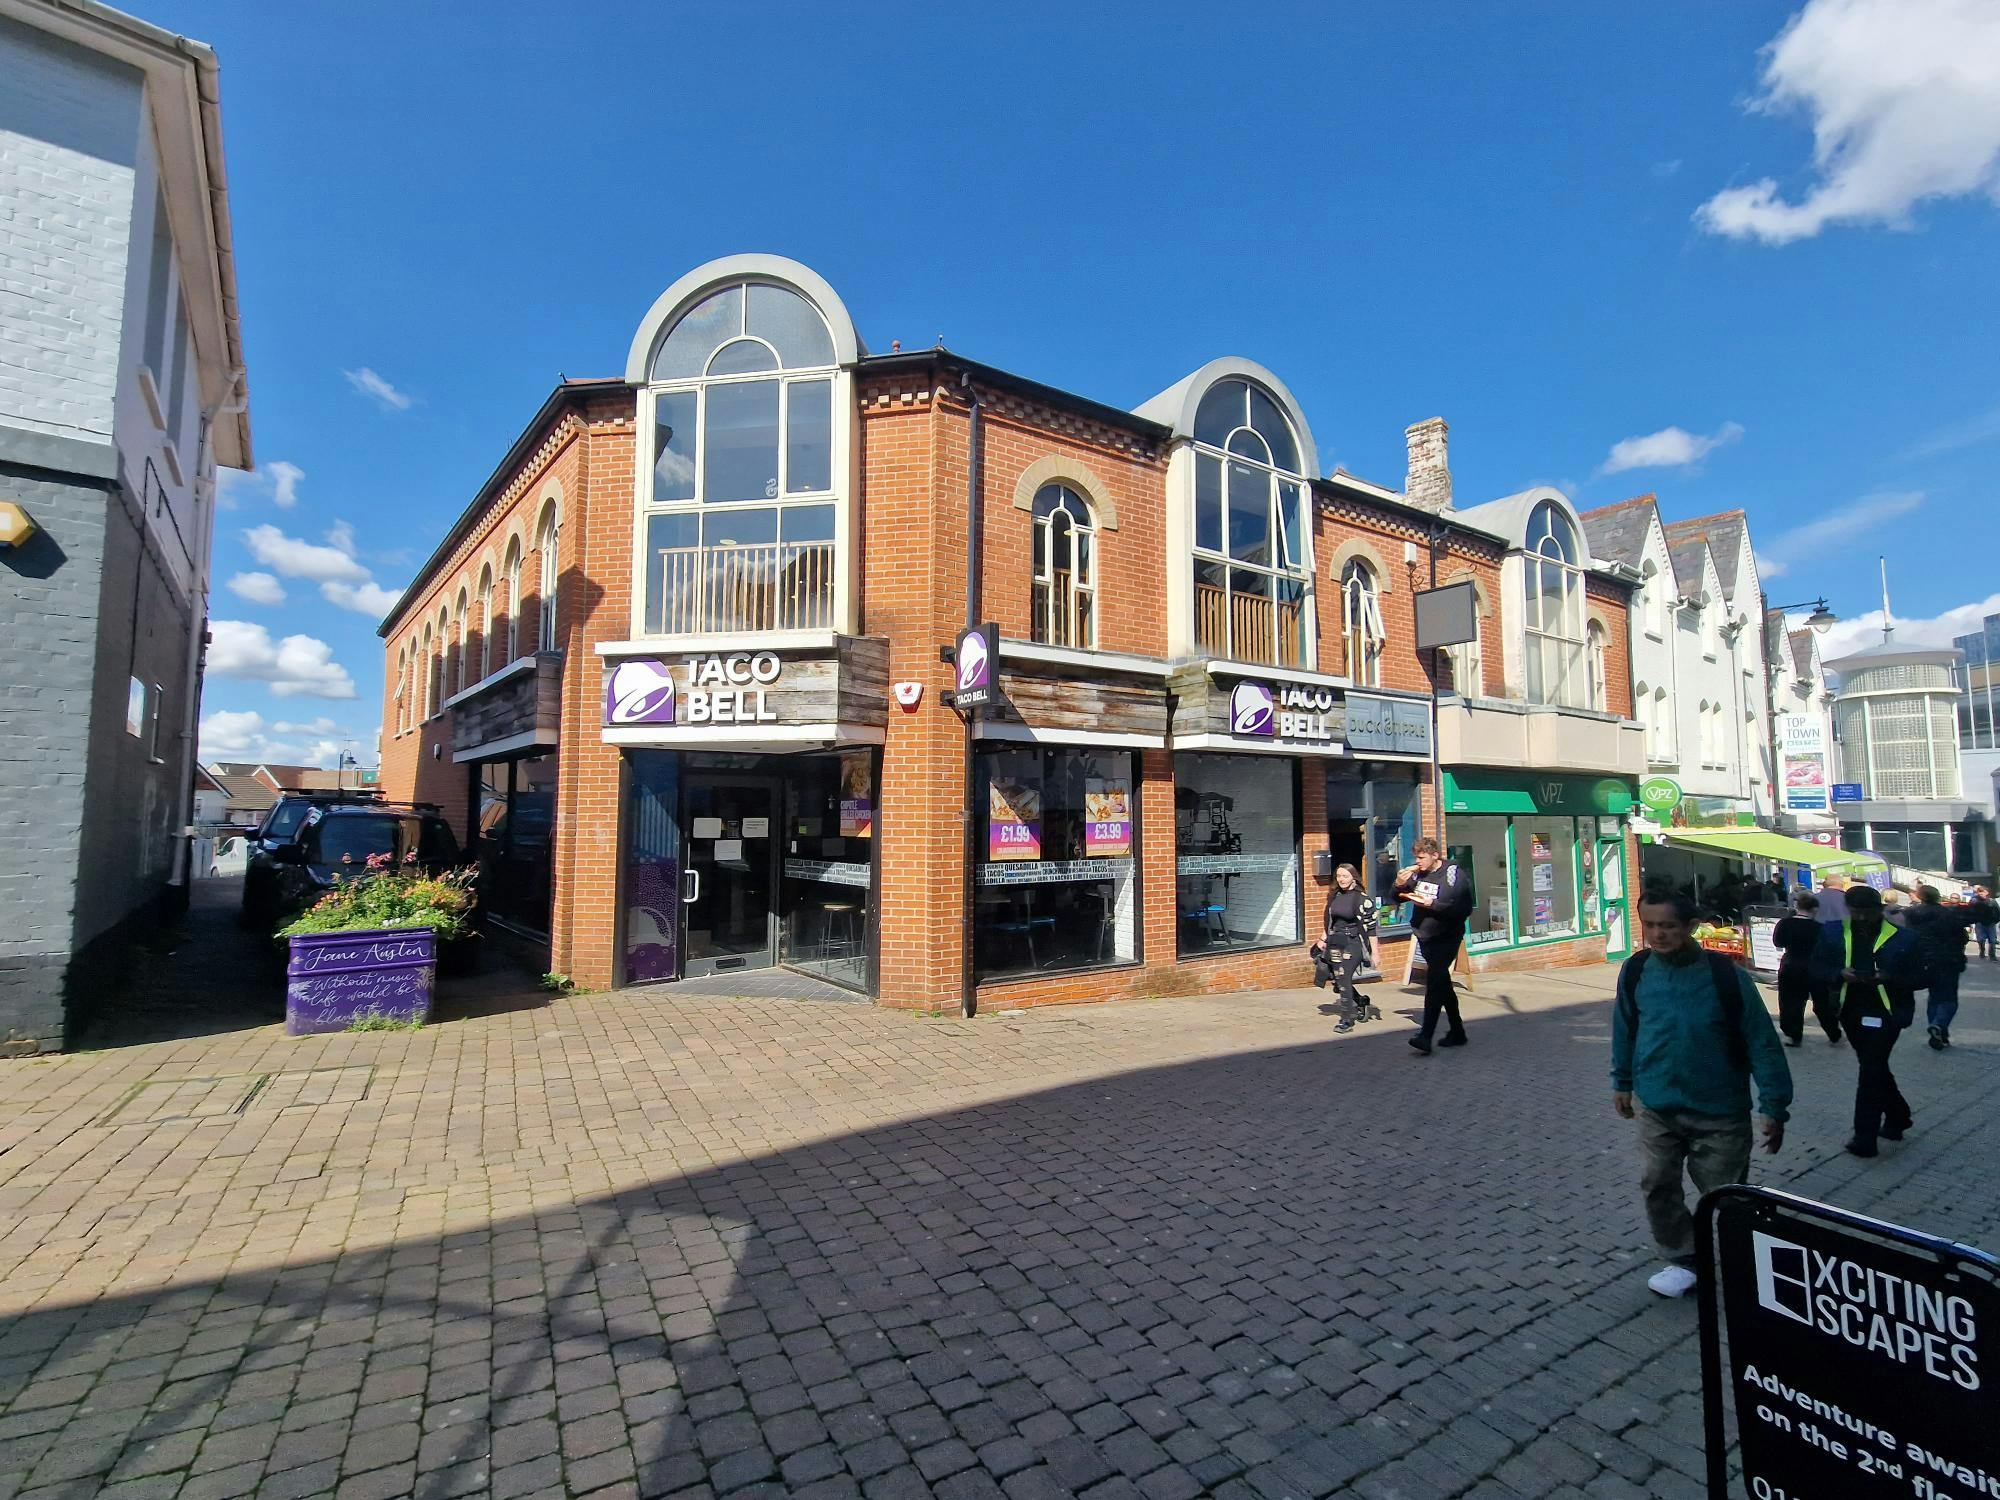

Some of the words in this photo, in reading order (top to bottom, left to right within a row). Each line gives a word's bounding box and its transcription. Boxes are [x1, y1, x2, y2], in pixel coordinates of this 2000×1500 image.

[683, 651, 781, 684] TACO
[957, 692, 973, 705] TACO
[972, 689, 988, 702] BELL
[1277, 681, 1333, 711] TACO
[687, 690, 778, 723] BELL
[1280, 711, 1331, 740] BELL
[1350, 719, 1381, 734] DUCK
[1787, 717, 1806, 728] TOP
[1787, 728, 1820, 739] TOWN
[1539, 783, 1565, 805] VPZ
[1646, 786, 1673, 801] VPZ
[1000, 825, 1030, 843] £1.99
[1094, 823, 1122, 840] £3.99
[305, 947, 360, 971] Jane
[362, 940, 430, 963] Austen
[313, 972, 378, 991] Without
[347, 984, 391, 1002] would
[1743, 1364, 1897, 1451] Adventure
[1756, 1404, 1792, 1433] on
[1798, 1421, 1848, 1461] the
[1857, 1447, 1904, 1481] 2nd
